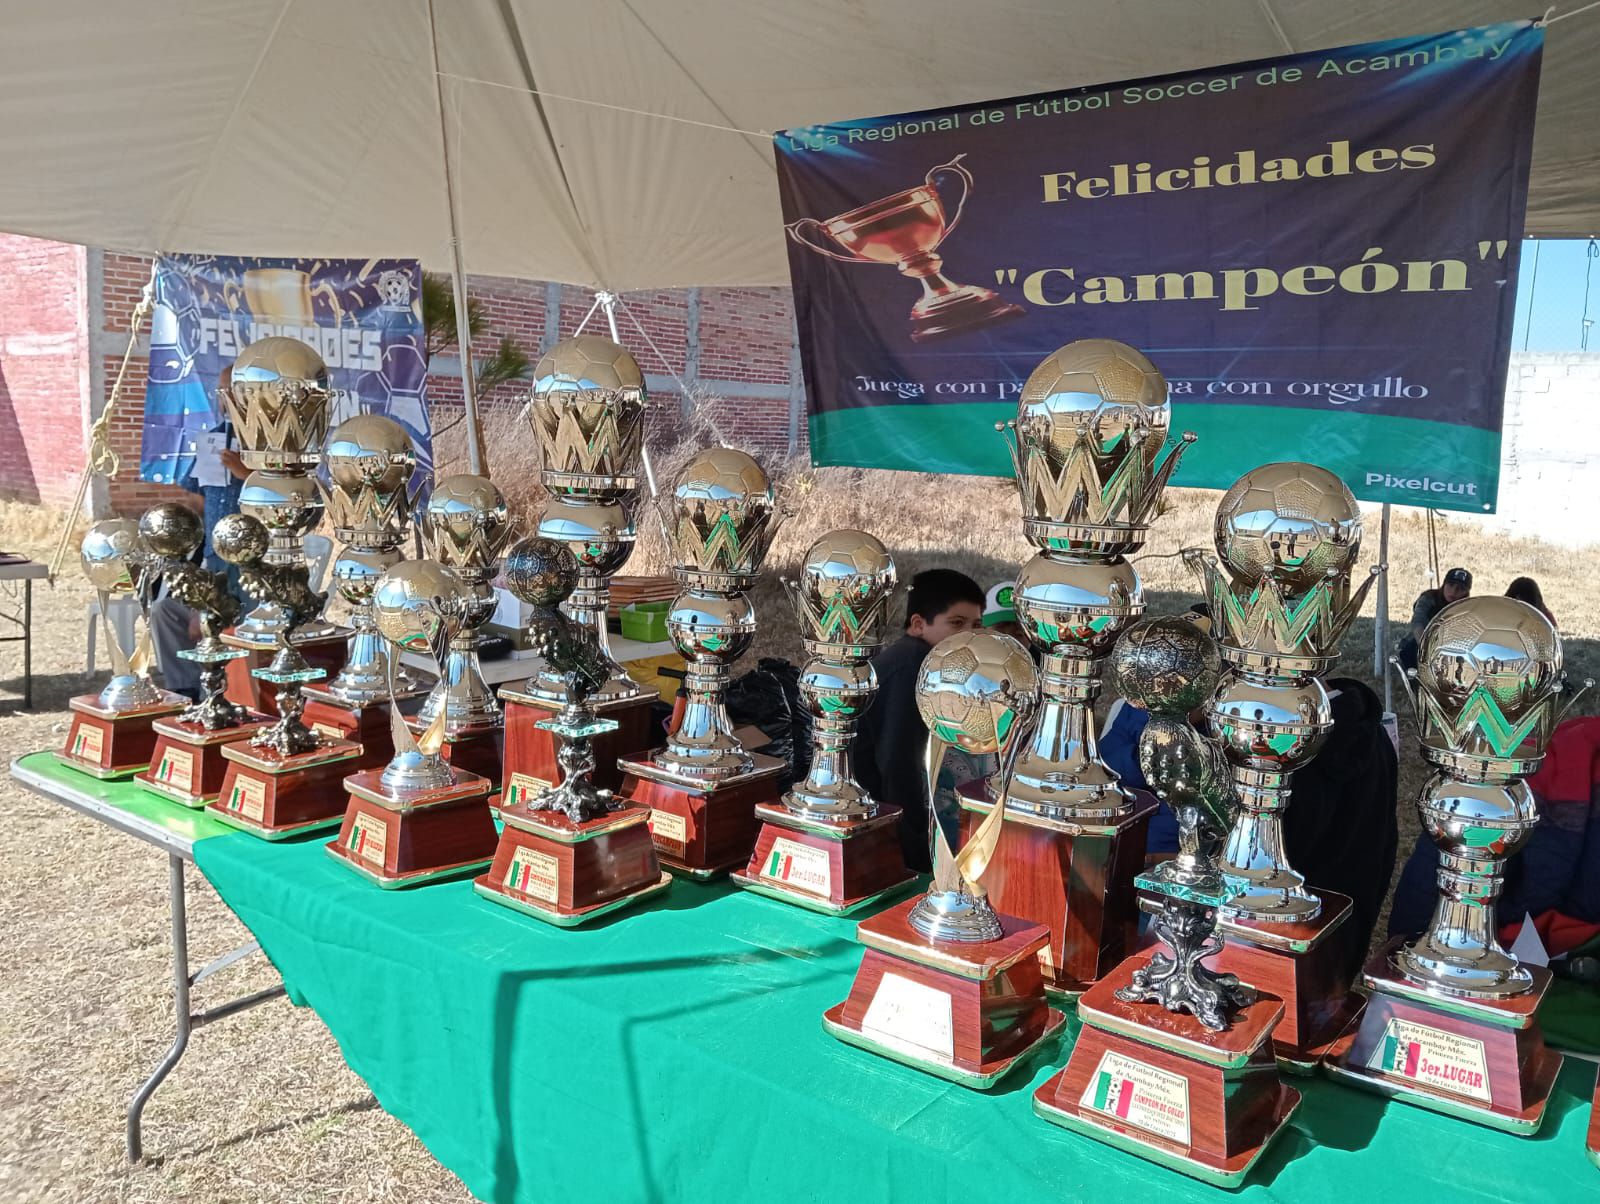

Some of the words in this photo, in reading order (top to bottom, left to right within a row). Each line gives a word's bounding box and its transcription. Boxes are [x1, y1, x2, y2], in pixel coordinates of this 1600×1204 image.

[790, 129, 839, 152] Liga
[849, 114, 960, 144] Regional
[970, 108, 1006, 127] de
[1015, 91, 1110, 120] Fútbol
[1123, 73, 1243, 104] Soccer
[1256, 65, 1303, 87] de
[1316, 37, 1513, 79] Acambay
[1040, 140, 1437, 203] Felicidades
[994, 240, 1508, 311] "Campeón"
[855, 375, 926, 399] Juega
[935, 382, 987, 394] con
[1205, 379, 1274, 395] con
[1287, 376, 1429, 404] orgullo
[1365, 471, 1478, 497] Pixelcut
[1413, 1037, 1447, 1051] Acambay
[1445, 1036, 1479, 1050] Regional
[1123, 1061, 1132, 1069] de
[1154, 1072, 1184, 1089] Regional
[1420, 1057, 1483, 1089] 3er.LUGAR
